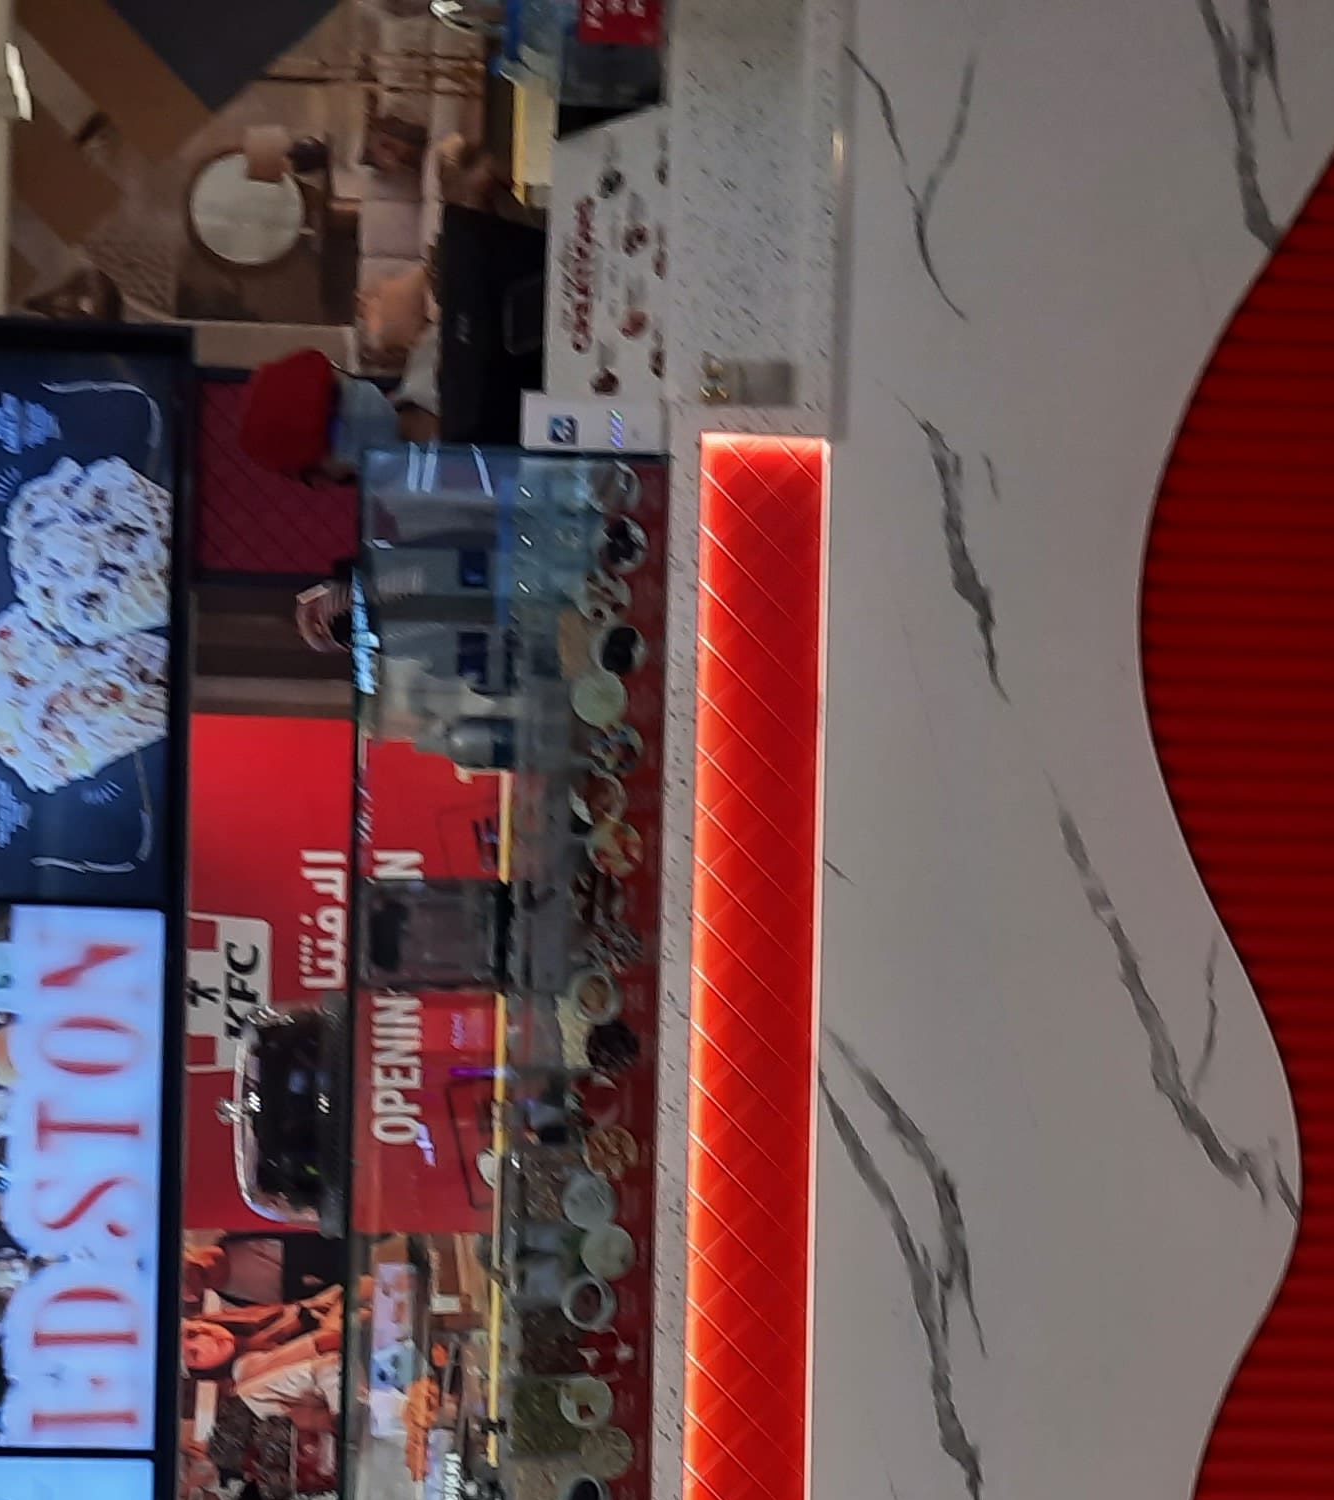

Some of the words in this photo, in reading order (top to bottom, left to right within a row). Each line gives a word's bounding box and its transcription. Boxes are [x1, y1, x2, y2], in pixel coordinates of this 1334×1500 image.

[298, 850, 348, 989] الافتتا
[224, 942, 261, 1040] KFC
[370, 989, 422, 1144] OPENIN
